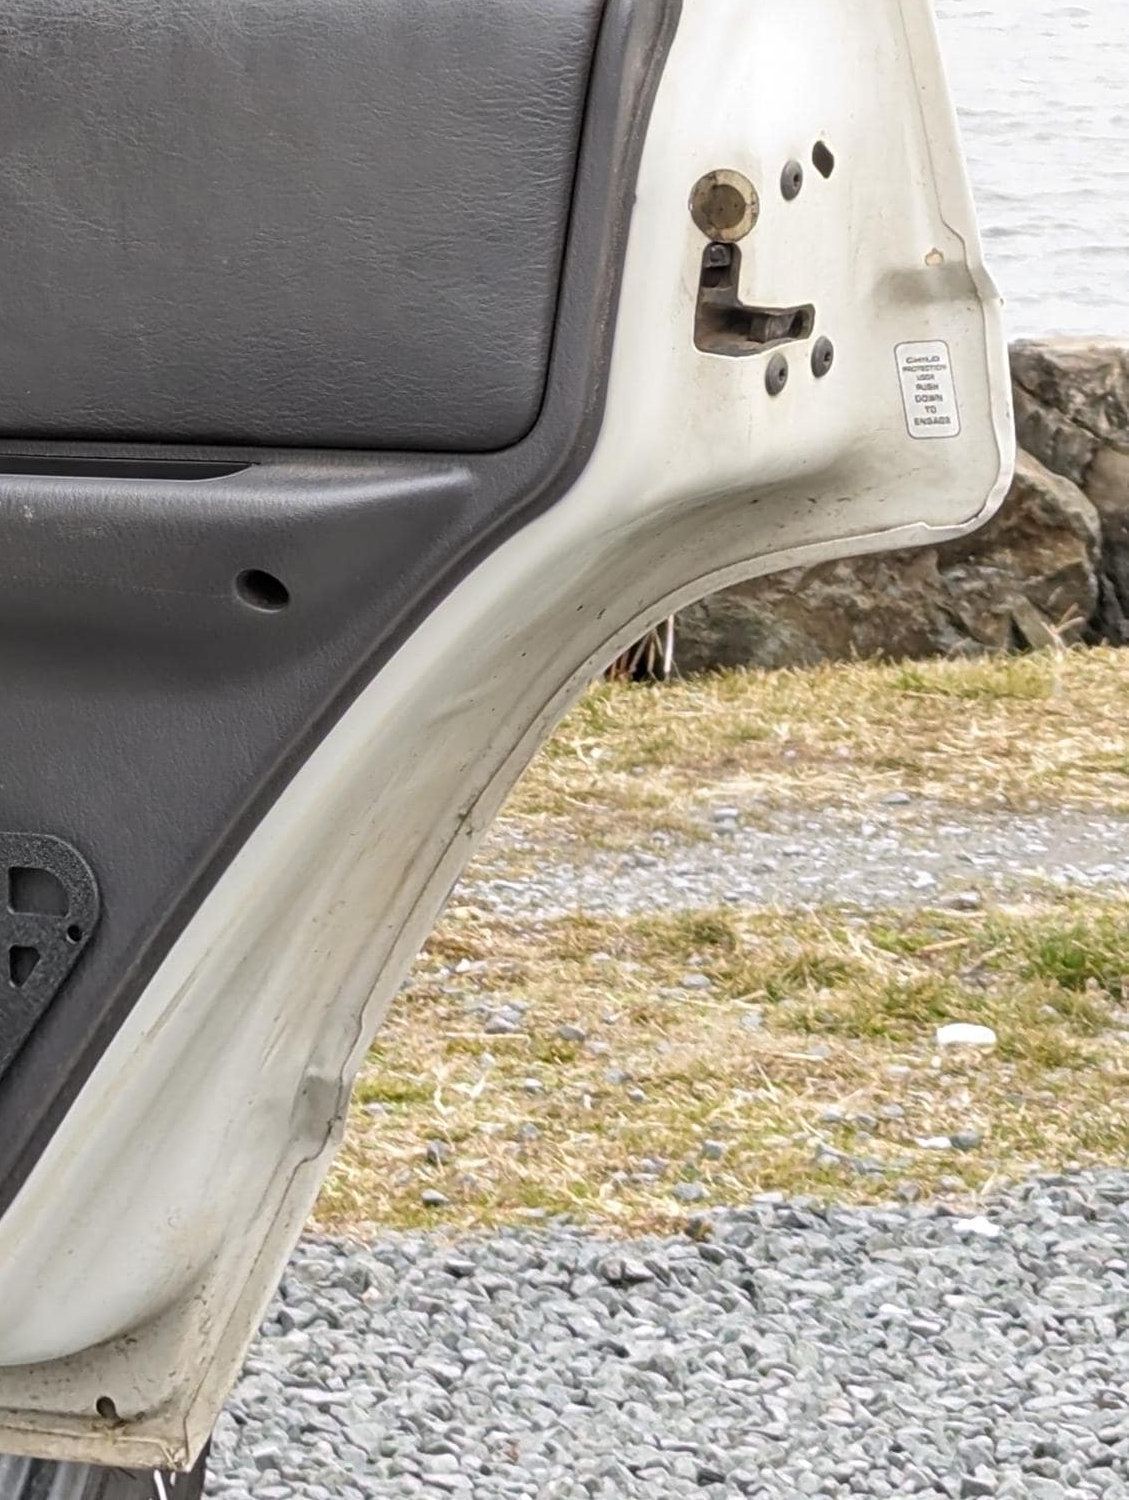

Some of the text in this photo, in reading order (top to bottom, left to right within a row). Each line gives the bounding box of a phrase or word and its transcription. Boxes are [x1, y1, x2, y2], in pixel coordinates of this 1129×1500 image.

[914, 394, 943, 403] DOWN
[925, 405, 937, 414] TO
[914, 416, 951, 425] ENGAGE
